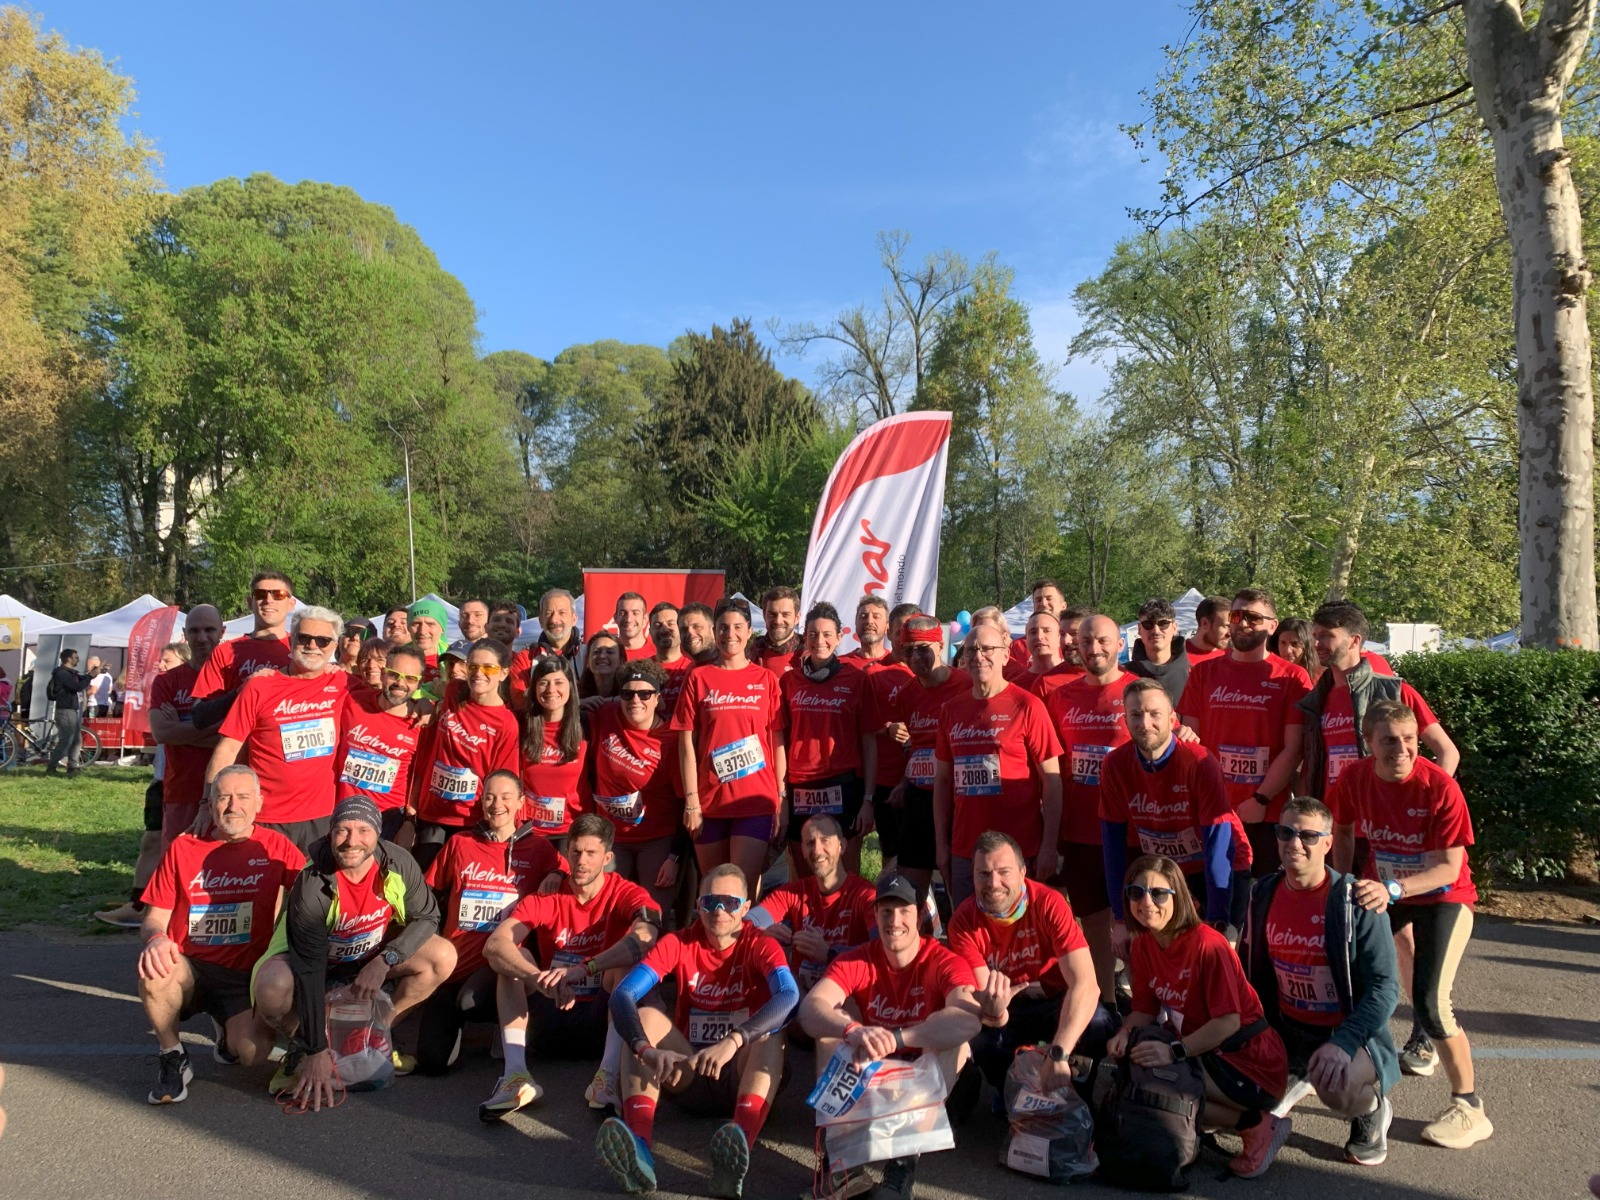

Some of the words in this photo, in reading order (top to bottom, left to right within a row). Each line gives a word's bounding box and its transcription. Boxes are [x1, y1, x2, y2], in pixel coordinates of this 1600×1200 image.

[896, 554, 906, 591] mondo
[144, 618, 158, 640] Verga
[126, 635, 142, 688] Fondazione
[704, 689, 762, 706] Aleimar
[790, 690, 846, 707] Aleimar
[1210, 686, 1272, 704] Aleimar
[273, 698, 336, 716] Aleimar
[1062, 706, 1126, 725] Aleimar
[439, 709, 487, 746] Aleimar
[910, 711, 938, 728] Aleim
[1321, 712, 1355, 730] leim
[949, 722, 1004, 740] Aleimar
[297, 732, 326, 750] 210C
[347, 724, 408, 757] Aleimar
[602, 734, 652, 768] Aleimar
[724, 750, 757, 773] 3731C
[1230, 760, 1258, 775] 212B
[352, 763, 386, 784] 3731A
[962, 770, 988, 786] 208B
[438, 776, 468, 793] 3731B
[806, 791, 830, 806] 214A
[1128, 792, 1190, 814] Aleimar
[1361, 818, 1426, 845] Aleimar
[1152, 842, 1188, 856] 220A
[188, 869, 264, 890] Aleimar
[461, 862, 526, 885] Aleimar
[473, 904, 502, 922] 210B
[205, 918, 236, 935] 210A
[555, 928, 606, 946] Aleima
[336, 942, 370, 956] 208C
[1288, 979, 1318, 1001] 211A
[868, 994, 925, 1020] Aleimar
